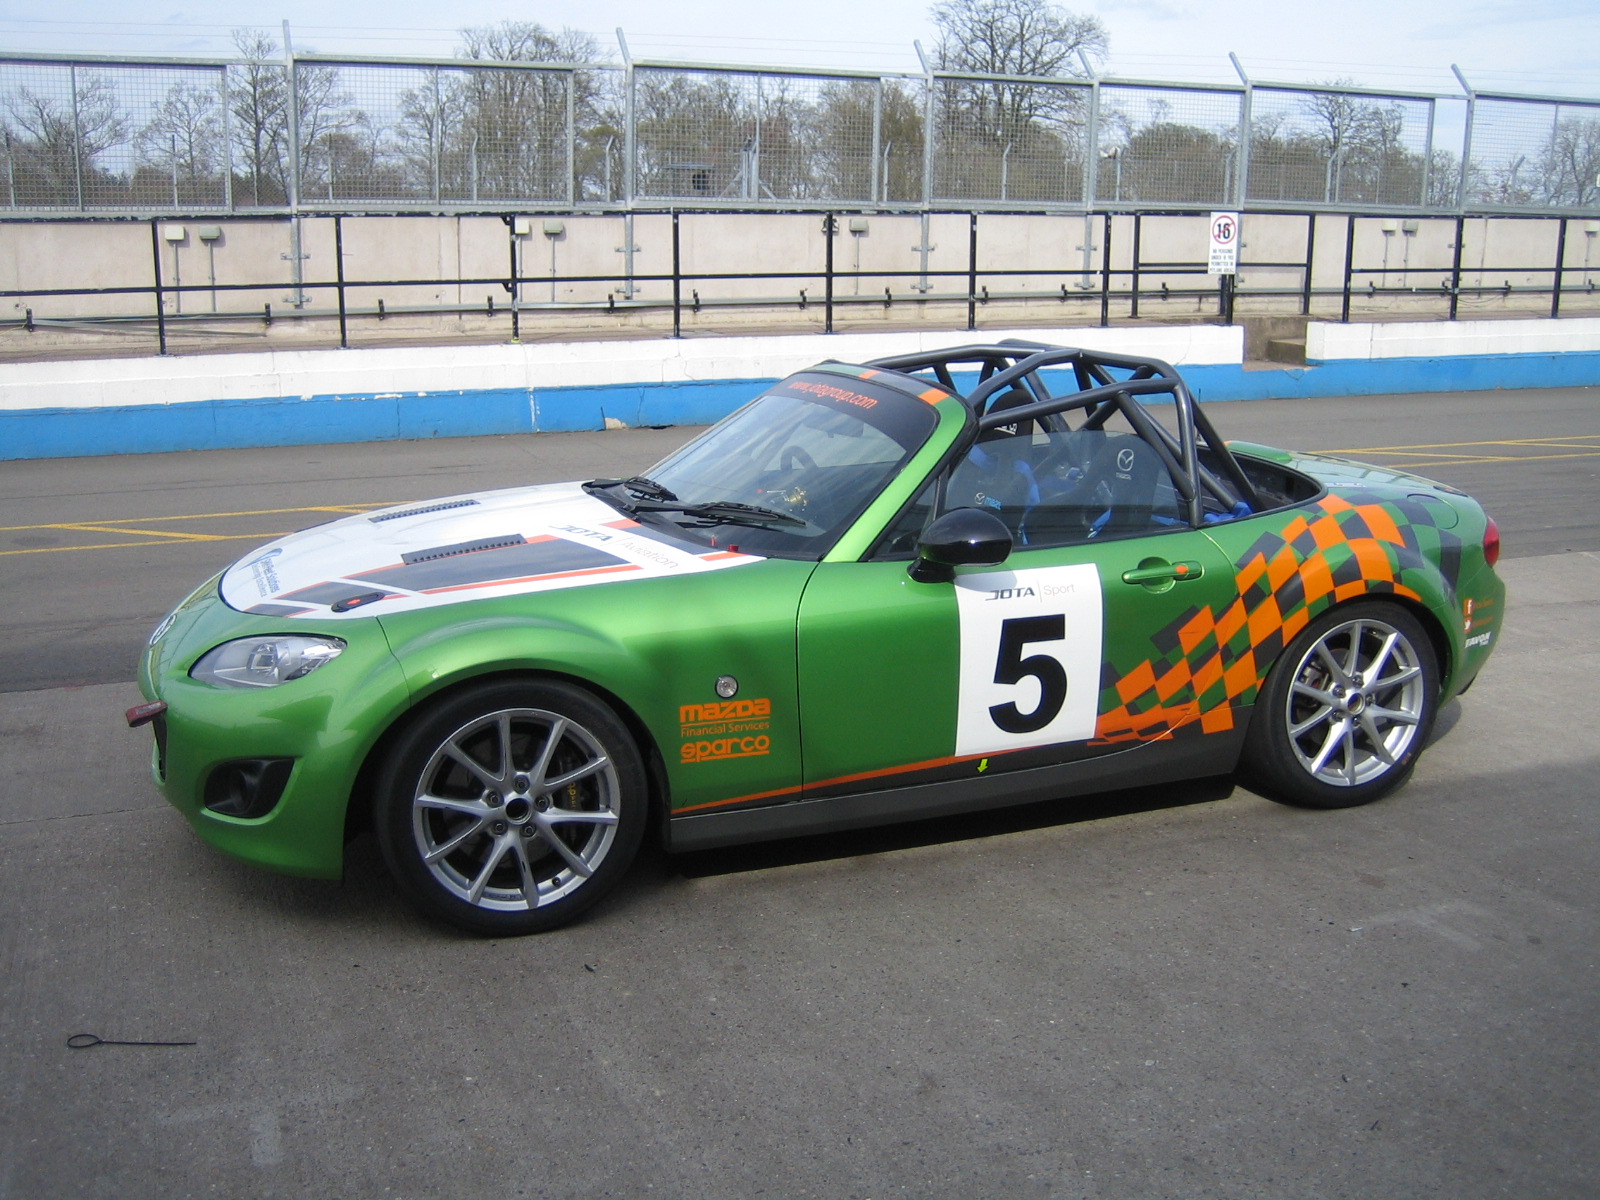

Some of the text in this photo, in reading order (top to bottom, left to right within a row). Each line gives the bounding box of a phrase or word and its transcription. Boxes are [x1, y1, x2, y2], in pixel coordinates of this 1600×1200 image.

[1217, 223, 1231, 239] 16
[548, 525, 679, 569] JOTA Aviation
[985, 583, 1075, 601] JOTA Sport
[988, 613, 1068, 734] 5
[681, 722, 770, 738] Financial Services
[680, 735, 771, 763] sparco
